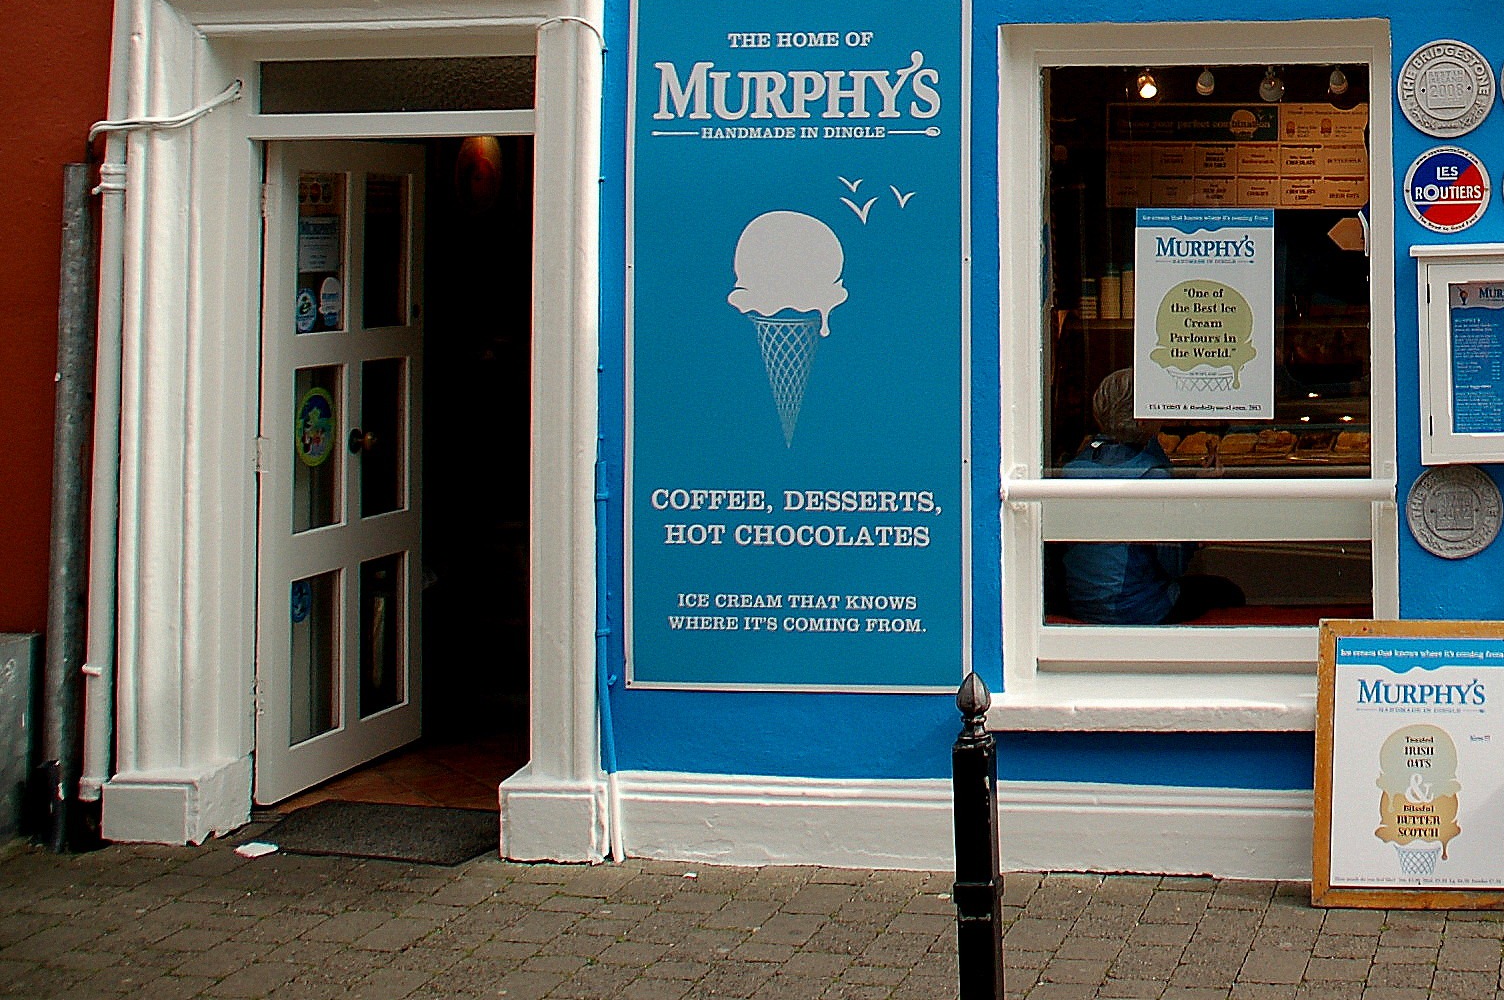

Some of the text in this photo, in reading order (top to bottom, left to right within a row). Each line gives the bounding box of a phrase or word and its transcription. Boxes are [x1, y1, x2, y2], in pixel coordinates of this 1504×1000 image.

[728, 32, 874, 48] THE HOME OF
[653, 50, 941, 120] MURPHY'S
[1402, 66, 1418, 98] THE
[702, 126, 886, 140] HANDMADE IN DINGLE
[1437, 166, 1458, 180] LES
[1415, 184, 1482, 201] ROUTIERS
[1155, 235, 1255, 257] MURPHY'S
[1213, 288, 1224, 298] of
[1171, 303, 1237, 313] the Best Ice
[1184, 318, 1222, 328] Cream
[1170, 332, 1236, 343] Parlours in
[1171, 348, 1190, 358] the
[651, 489, 942, 516] COFFEE, DESSERTS,
[665, 524, 930, 547] HOT CHOCOLATES
[677, 593, 917, 611] ICE CREAM THAT KNOWS
[668, 616, 927, 633] WHERE IT'S COMING FROM.
[1357, 678, 1486, 705] MURPHY'S
[1404, 746, 1434, 755] IRISH
[1407, 759, 1432, 768] OATS
[1405, 773, 1434, 803] &
[1397, 815, 1440, 824] BUTTER
[1398, 827, 1439, 837] SCOTCH
